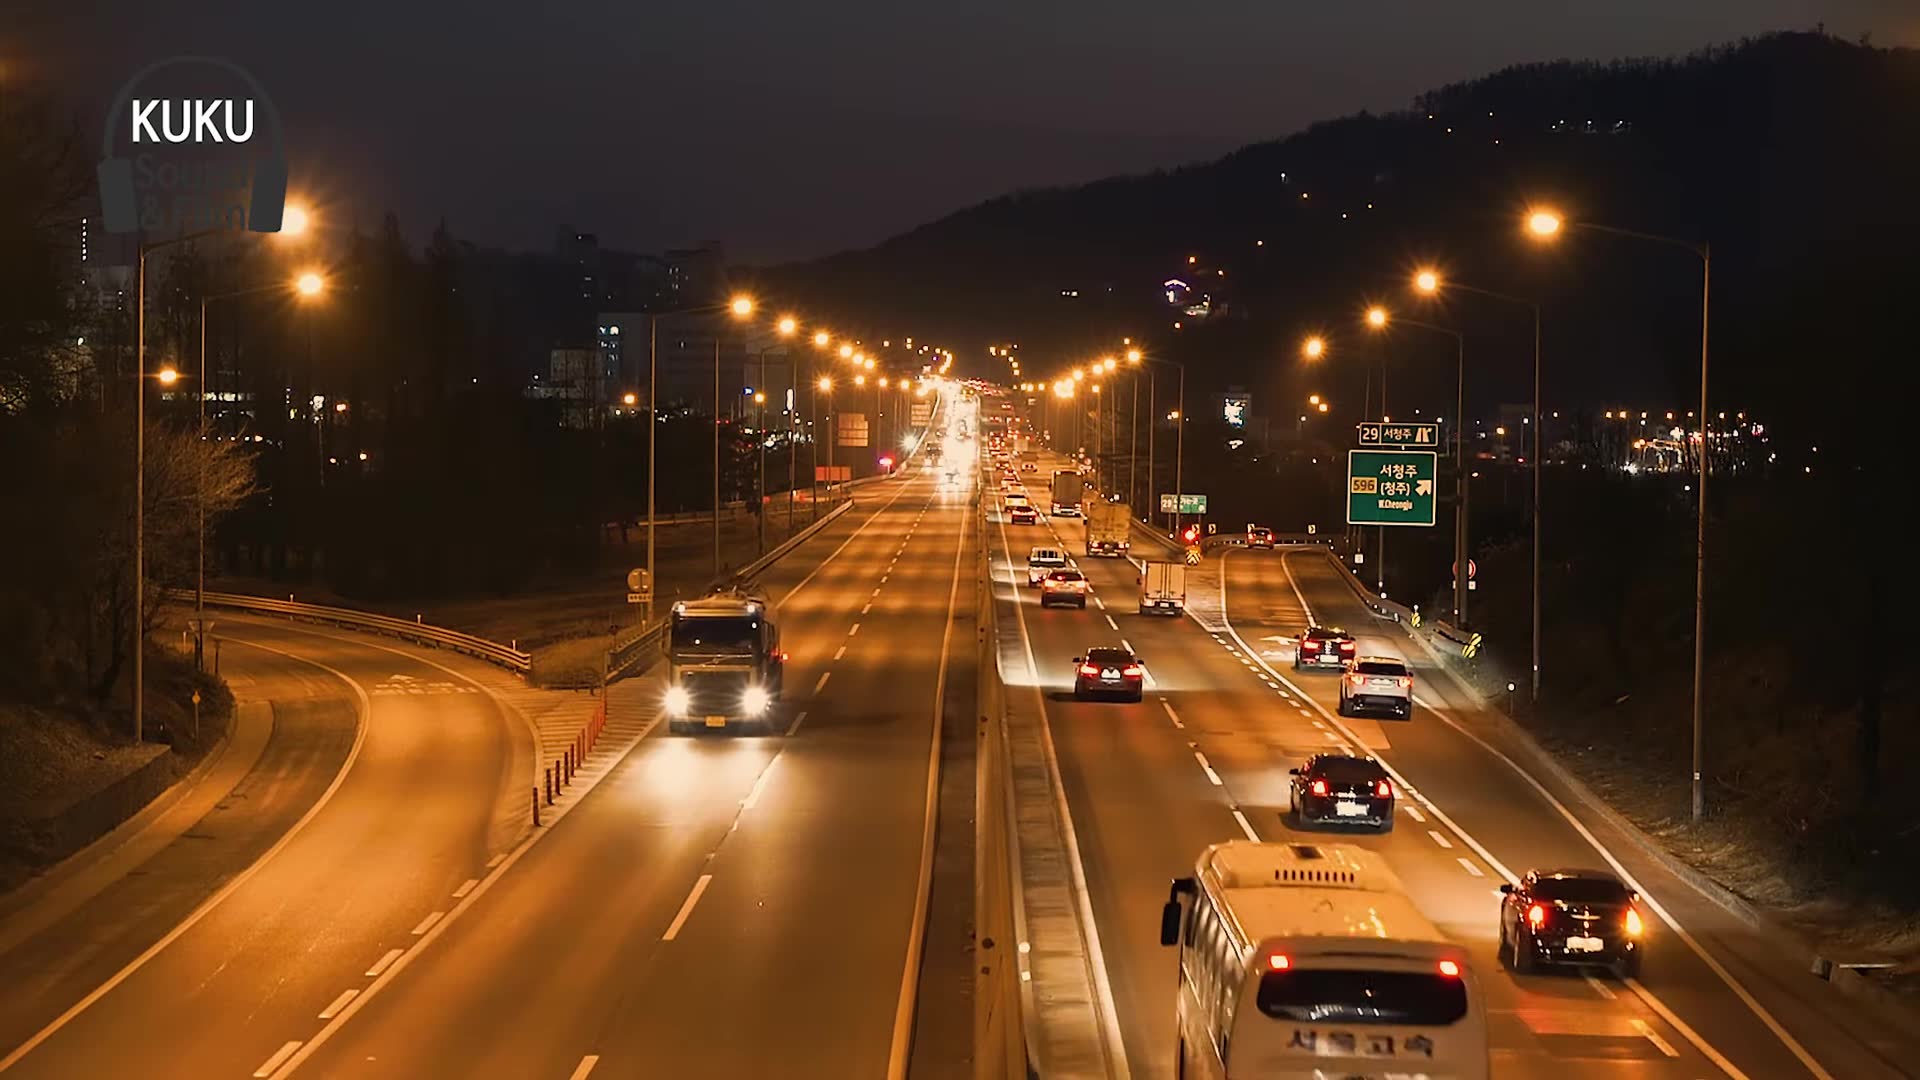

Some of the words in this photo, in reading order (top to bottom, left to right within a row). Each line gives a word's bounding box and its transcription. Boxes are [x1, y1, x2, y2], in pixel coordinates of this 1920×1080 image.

[1362, 428, 1379, 440] 29
[1383, 428, 1412, 440] 서청주
[1380, 464, 1417, 479] 서청주
[1352, 480, 1375, 491] 596
[1380, 481, 1411, 496] (청주)
